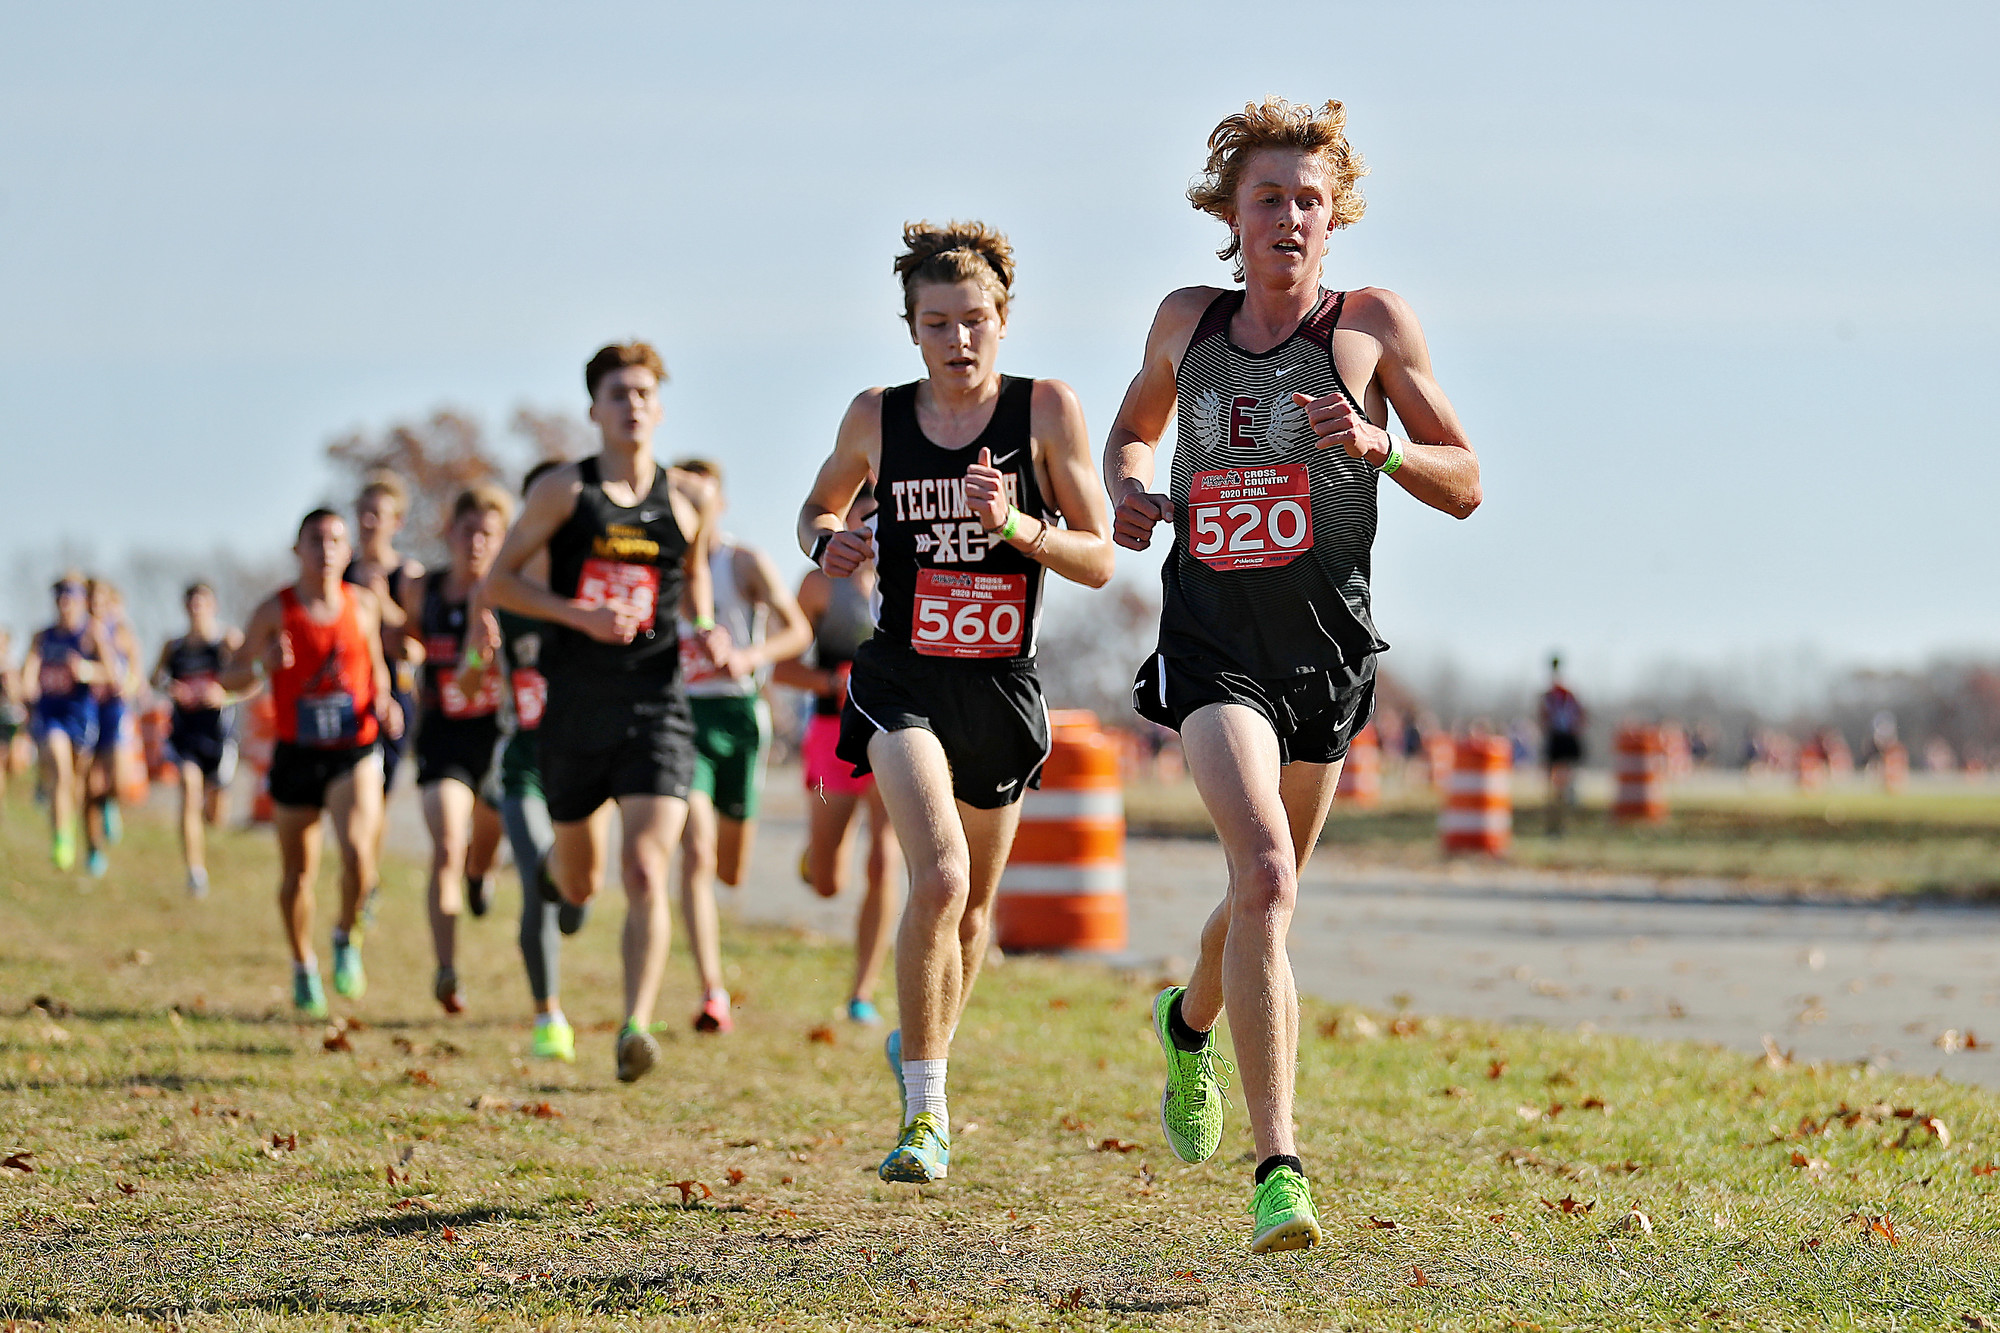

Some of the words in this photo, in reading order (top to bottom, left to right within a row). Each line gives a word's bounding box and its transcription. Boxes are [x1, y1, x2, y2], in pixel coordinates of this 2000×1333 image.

[1228, 395, 1262, 449] E
[1220, 489, 1241, 499] 2020
[1242, 487, 1268, 497] FINAL
[1243, 469, 1276, 478] CROSS
[1244, 475, 1289, 486] COUNTRY
[891, 472, 1018, 521] TECUMH
[931, 522, 985, 563] XC
[1195, 500, 1307, 555] 520
[950, 588, 970, 598] 2020
[917, 599, 1021, 644] 560
